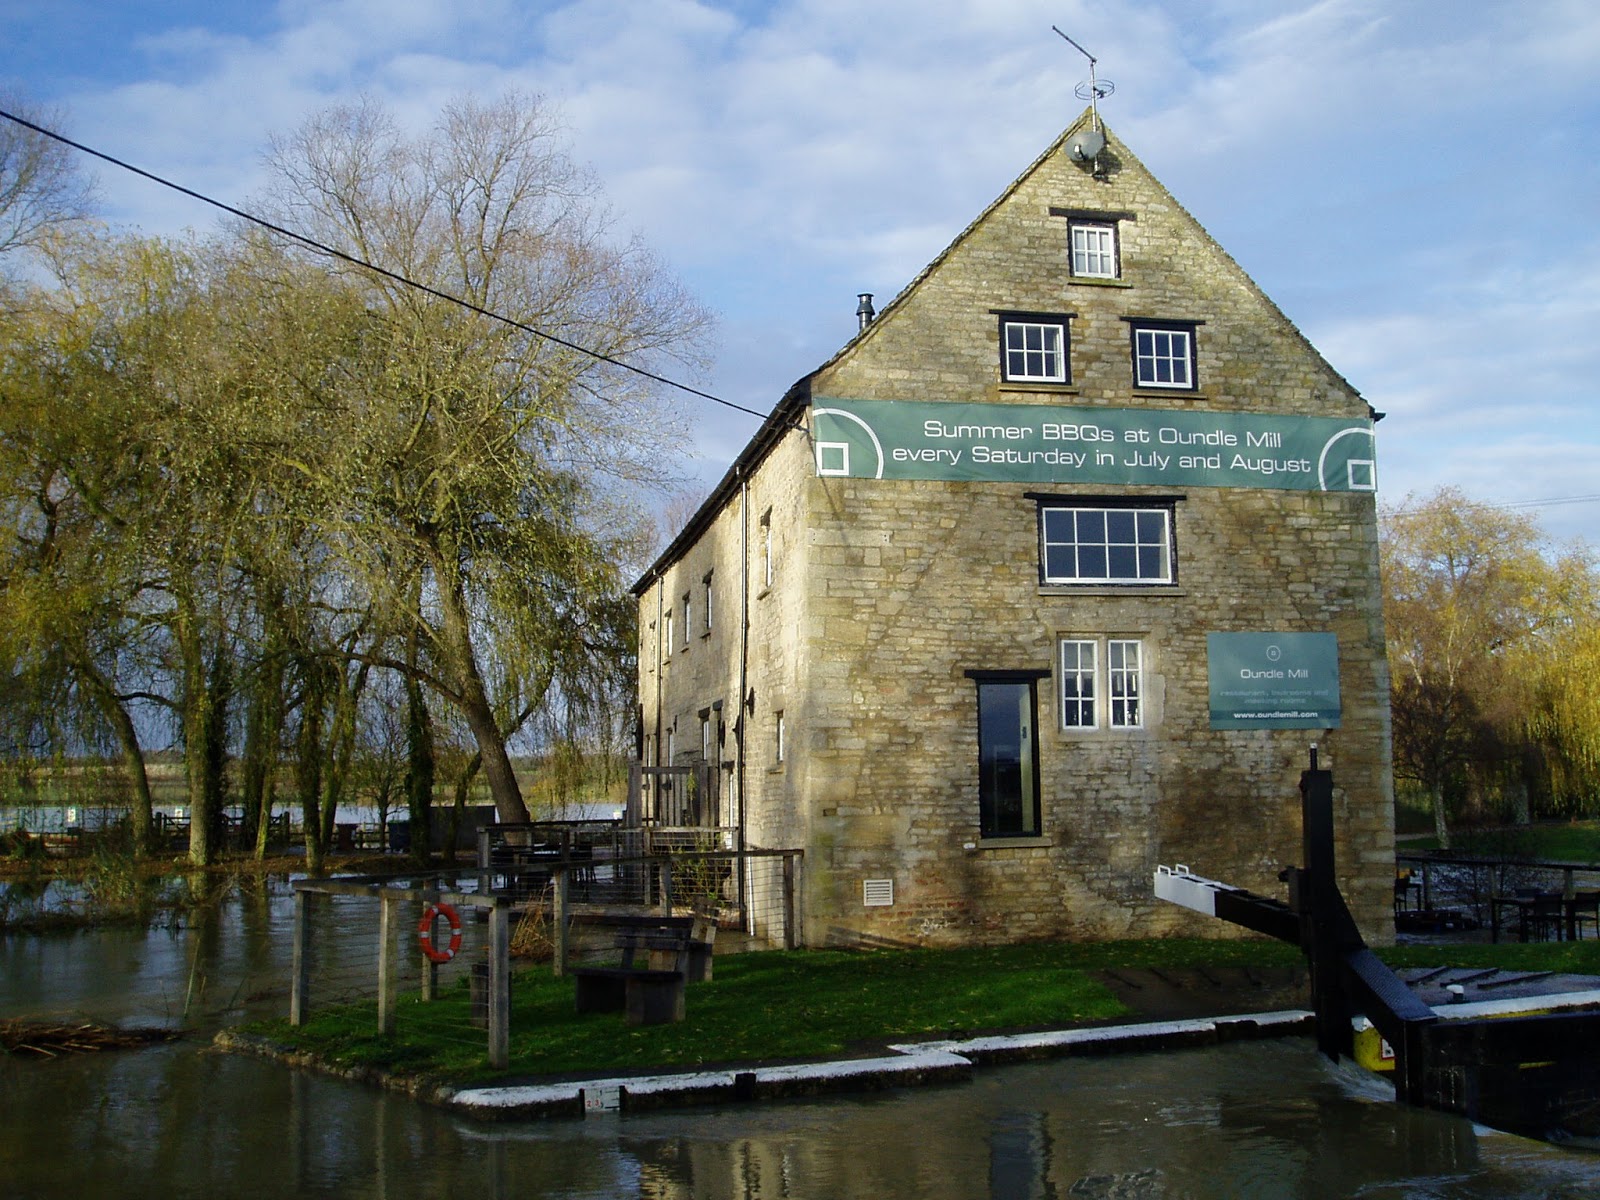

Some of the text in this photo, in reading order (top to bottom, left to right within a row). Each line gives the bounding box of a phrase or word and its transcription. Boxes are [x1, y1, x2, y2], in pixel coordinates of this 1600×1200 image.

[924, 420, 1281, 448] Summer BBQs at Oundle Mill
[892, 446, 1311, 475] every Saturday in July and August
[1240, 669, 1308, 679] Oundle Mill
[1233, 711, 1318, 719] www.oundlemill.com
